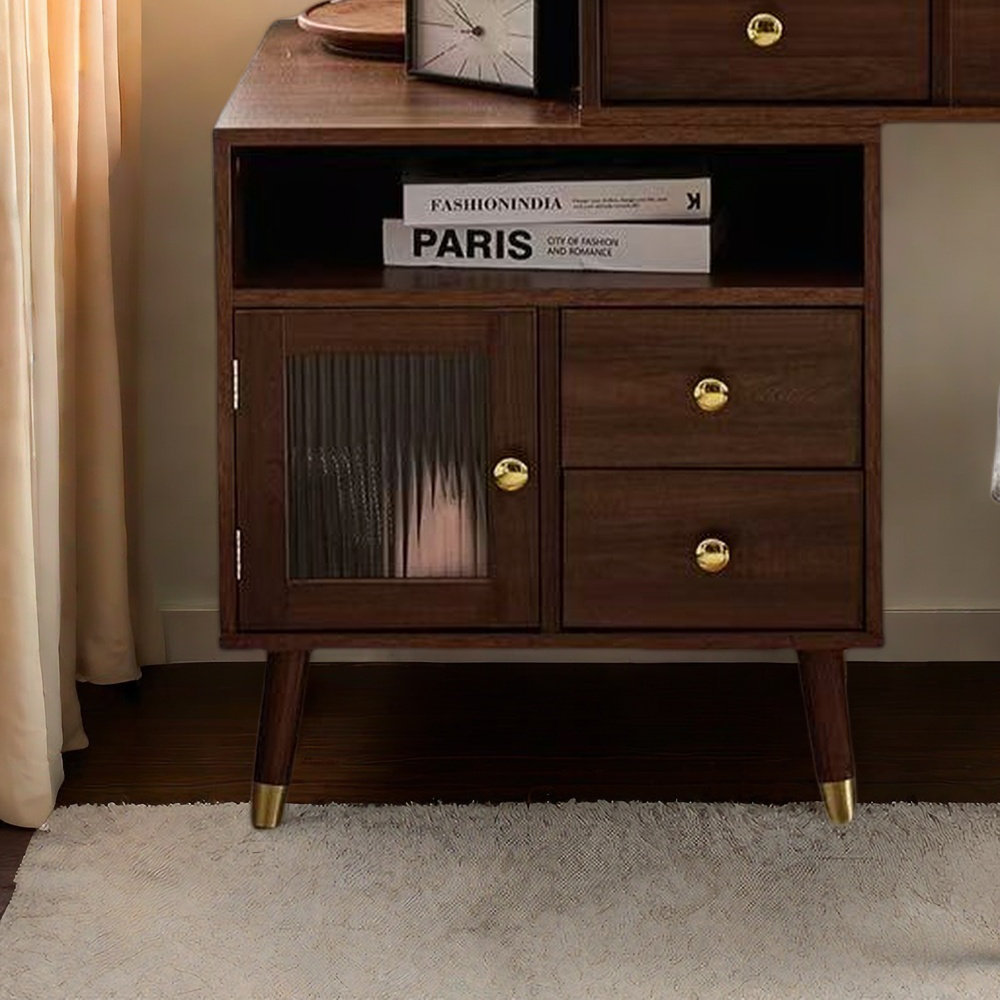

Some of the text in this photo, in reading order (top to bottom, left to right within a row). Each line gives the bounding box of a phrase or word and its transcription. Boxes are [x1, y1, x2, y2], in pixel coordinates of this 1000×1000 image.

[430, 197, 562, 212] FASHIONINDIA
[412, 228, 533, 260] PARIS
[546, 236, 619, 248] CITY OF FASHION
[546, 246, 613, 258] AND ROMANCE
